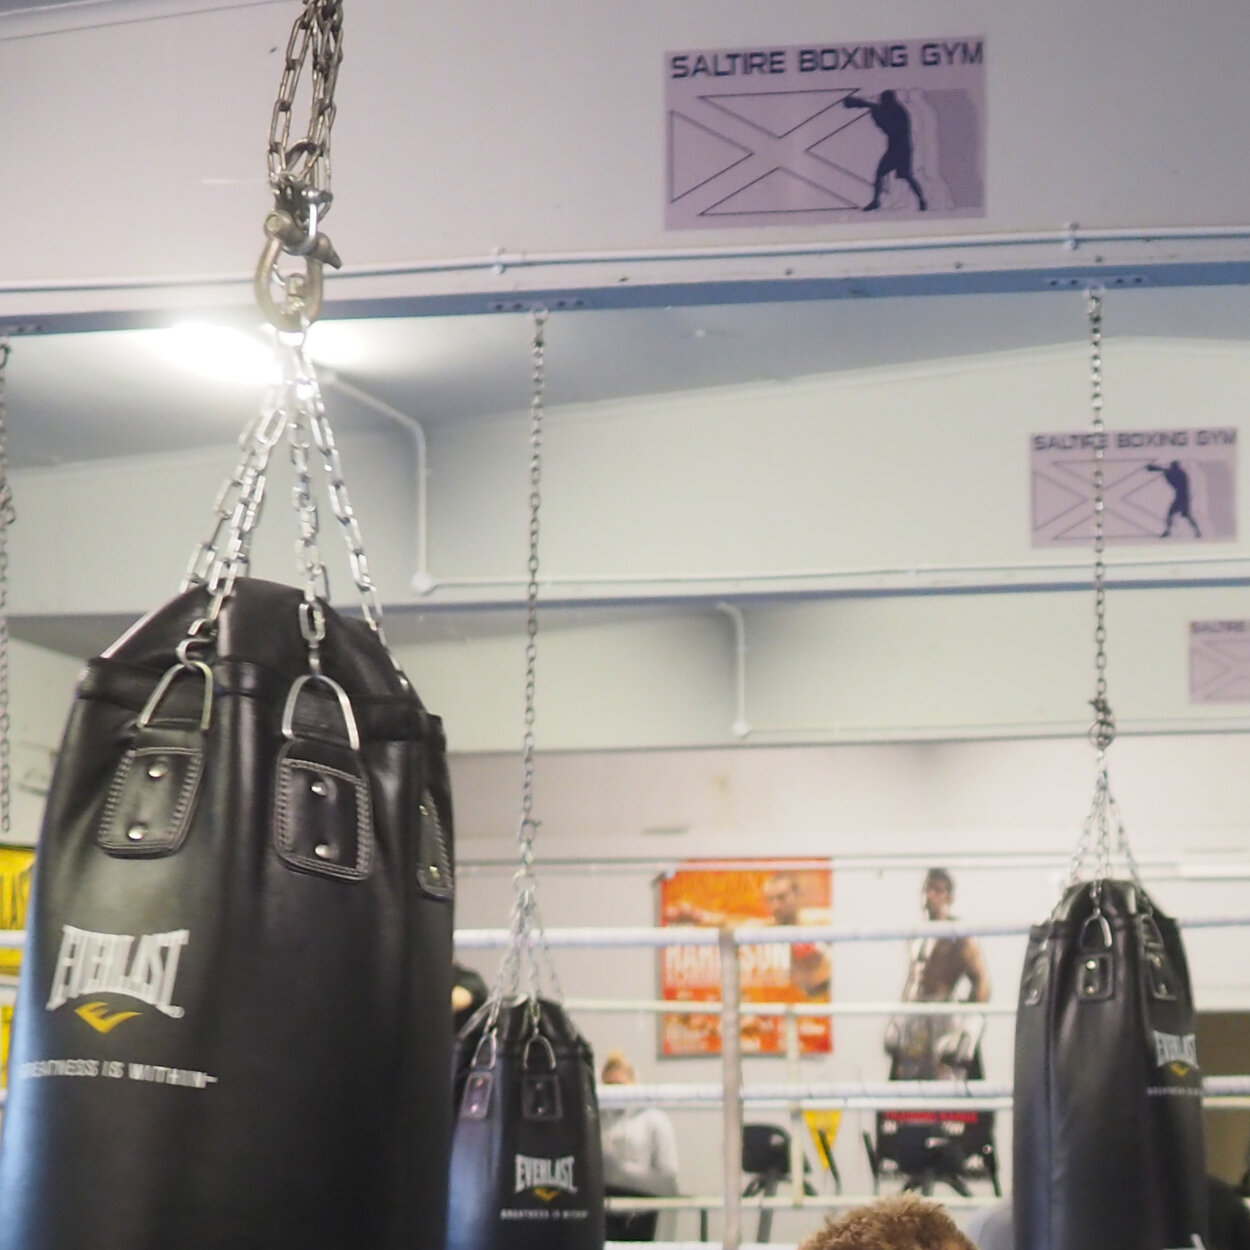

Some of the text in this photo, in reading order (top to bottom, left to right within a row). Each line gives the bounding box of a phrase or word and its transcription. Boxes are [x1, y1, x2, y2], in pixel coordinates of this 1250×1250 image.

[671, 42, 984, 78] SALTIRE BOXING GYM
[1117, 431, 1189, 448] BOXING
[1196, 429, 1238, 446] GYM
[1153, 1029, 1199, 1070] EVERLAST
[514, 1153, 578, 1194] EVERLAST
